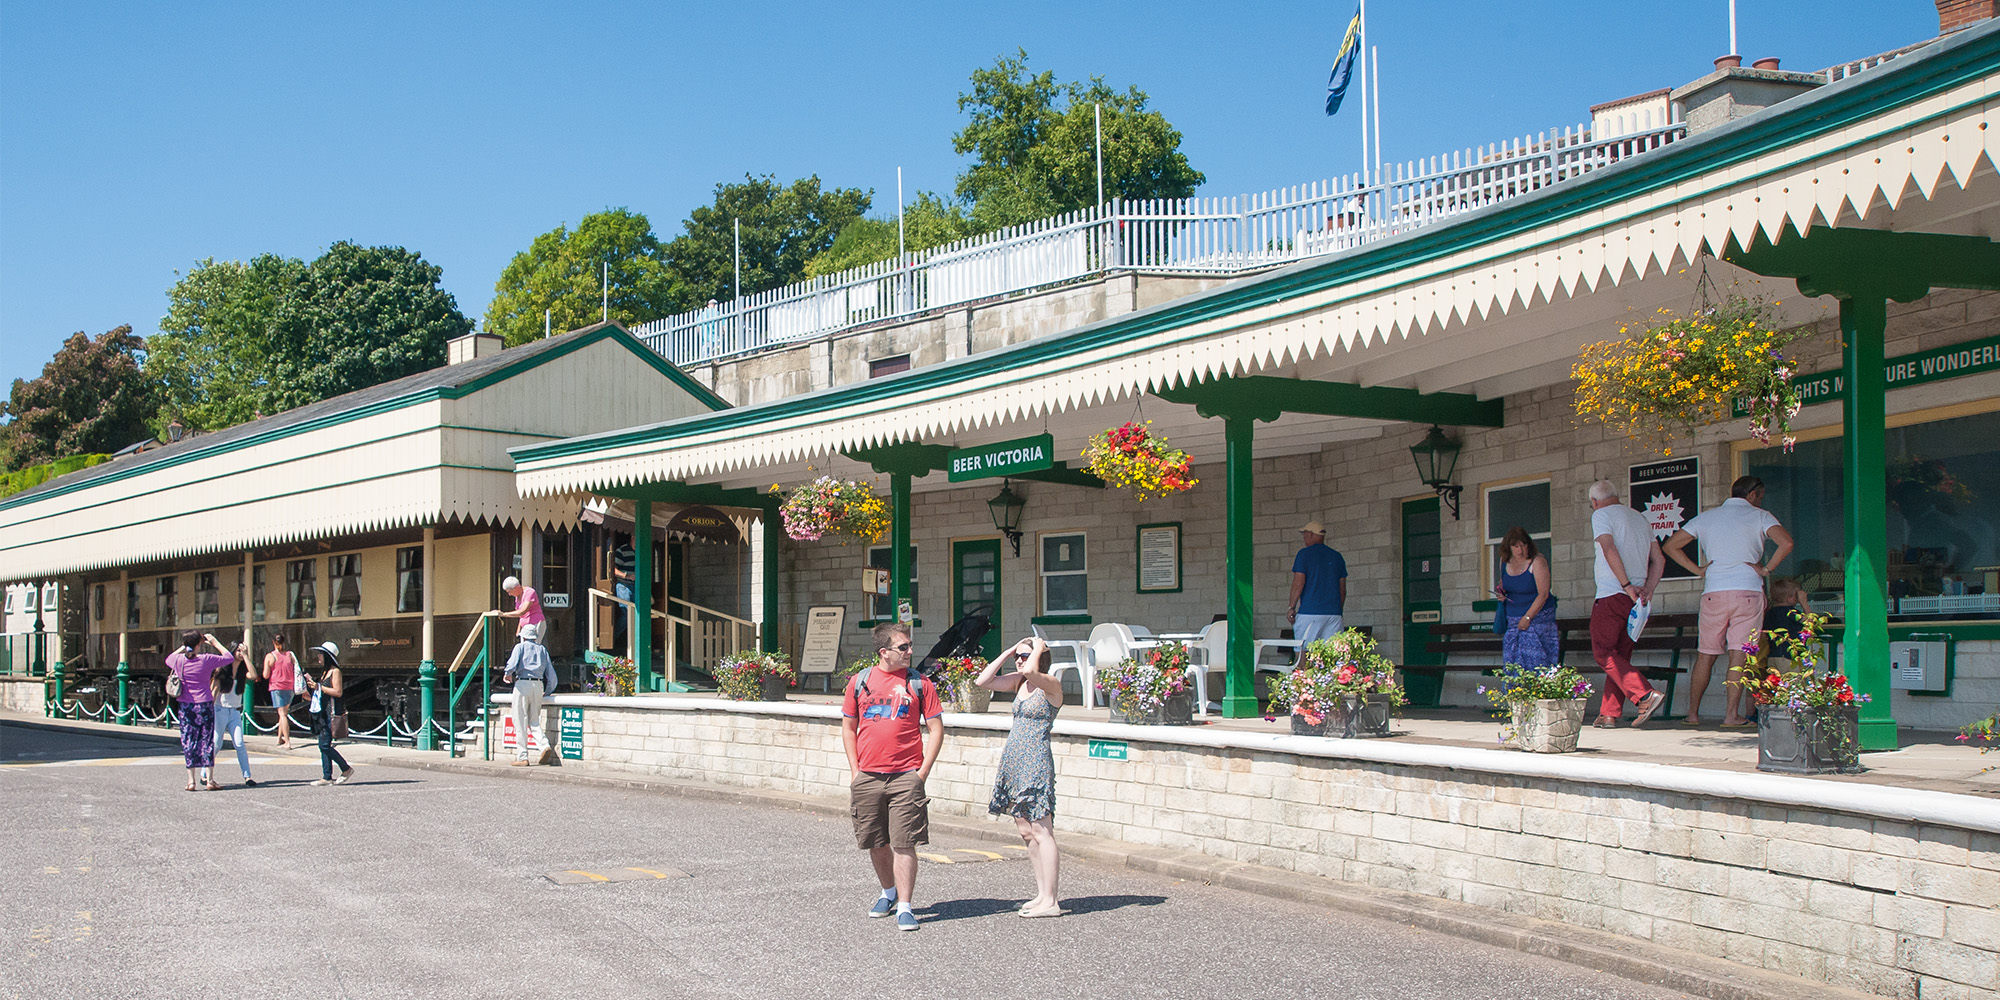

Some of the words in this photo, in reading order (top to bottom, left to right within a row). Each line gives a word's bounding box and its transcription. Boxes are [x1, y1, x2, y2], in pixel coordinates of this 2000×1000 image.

[1793, 377, 1830, 399] GHTS
[953, 455, 982, 473] BEER
[985, 446, 1043, 468] VICTORIA
[1639, 468, 1655, 477] BEER
[1655, 464, 1688, 474] VICTORIA
[1650, 502, 1674, 512] DRIVE
[691, 517, 716, 526] ORION
[1650, 521, 1675, 530] TRAIN
[544, 596, 568, 605] OPEN
[564, 710, 572, 719] To
[572, 710, 580, 719] the
[561, 719, 582, 728] Gardens
[561, 741, 582, 749] TOILETS
